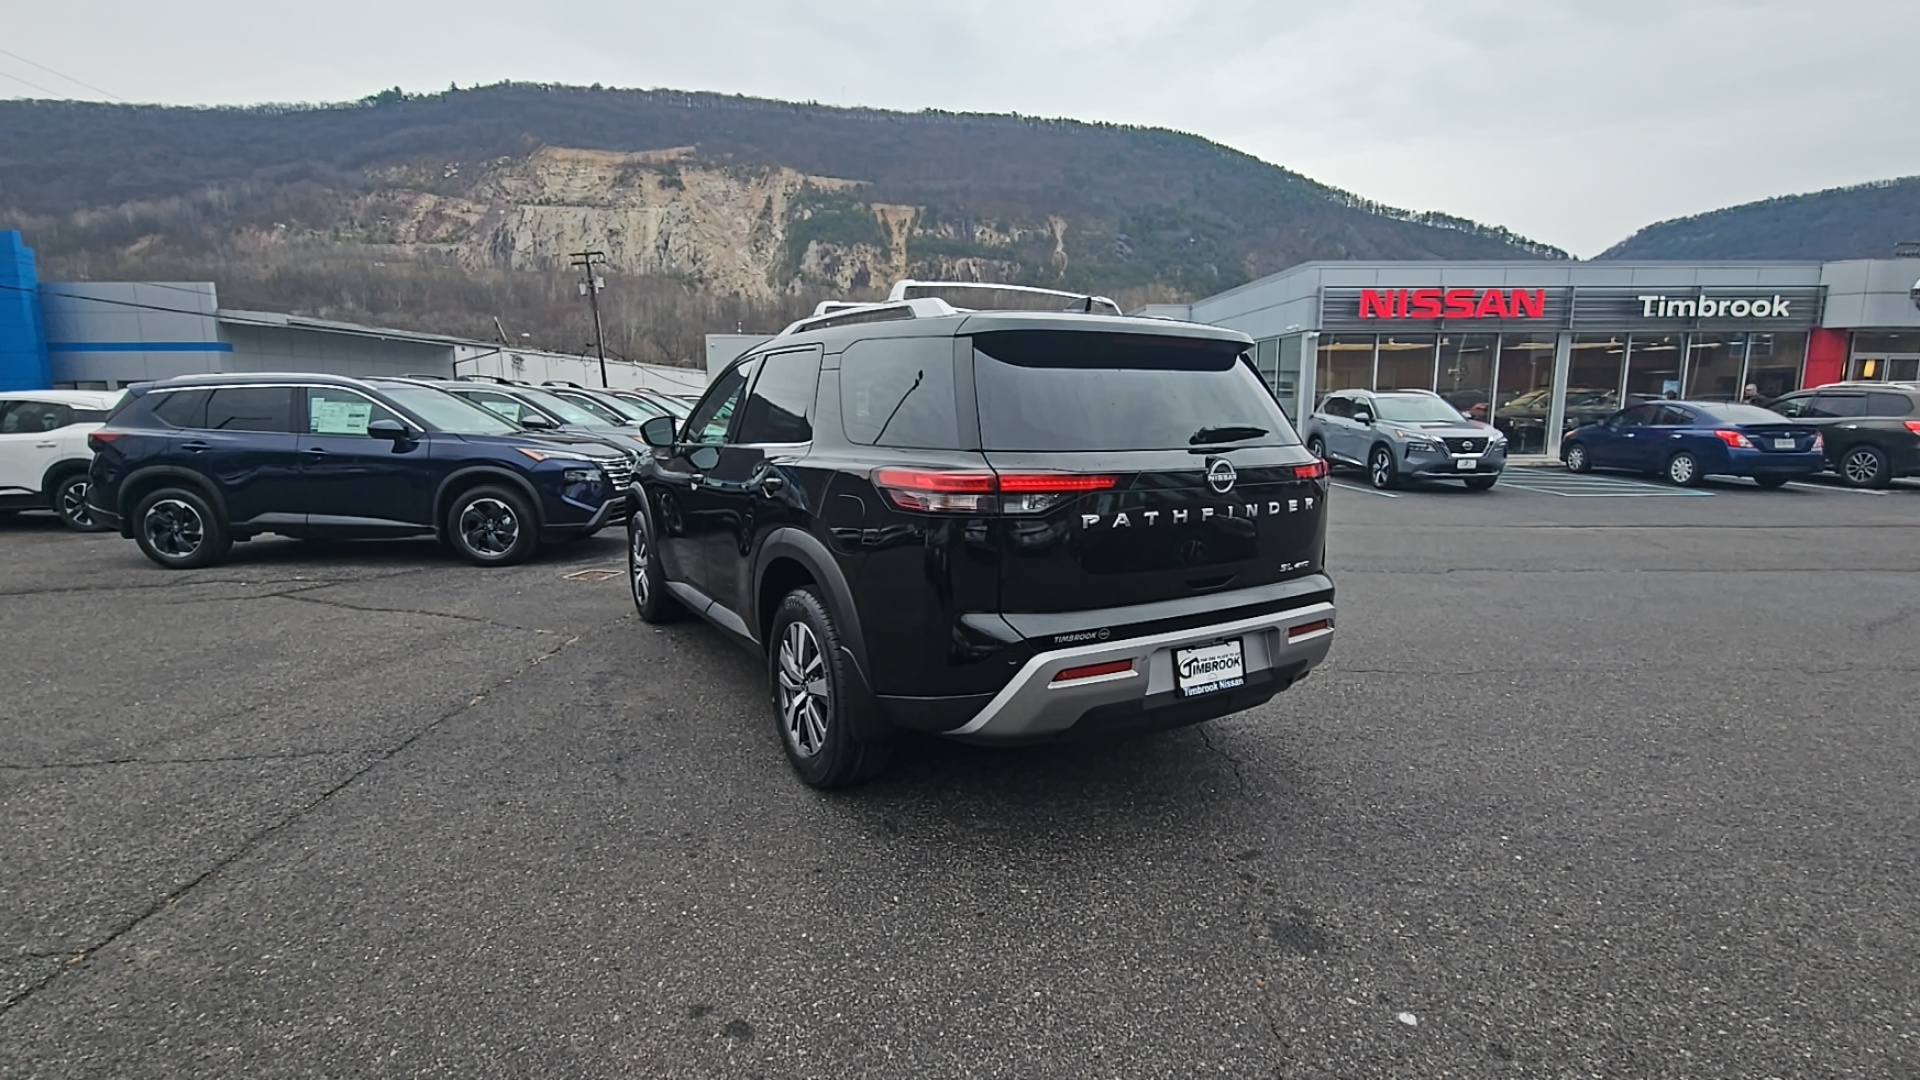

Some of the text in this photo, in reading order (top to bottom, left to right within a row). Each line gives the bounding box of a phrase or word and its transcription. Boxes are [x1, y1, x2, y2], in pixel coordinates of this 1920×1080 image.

[1359, 289, 1545, 319] NISSAN
[1638, 295, 1790, 317] Timbrook
[1208, 473, 1237, 481] NISSAN
[1081, 497, 1314, 529] PATHFINDER
[1280, 562, 1293, 572] SL
[1054, 632, 1097, 643] TIMBROOK
[1180, 656, 1240, 679] TIMBROOK
[1184, 678, 1244, 697] Timbrook Nissan
